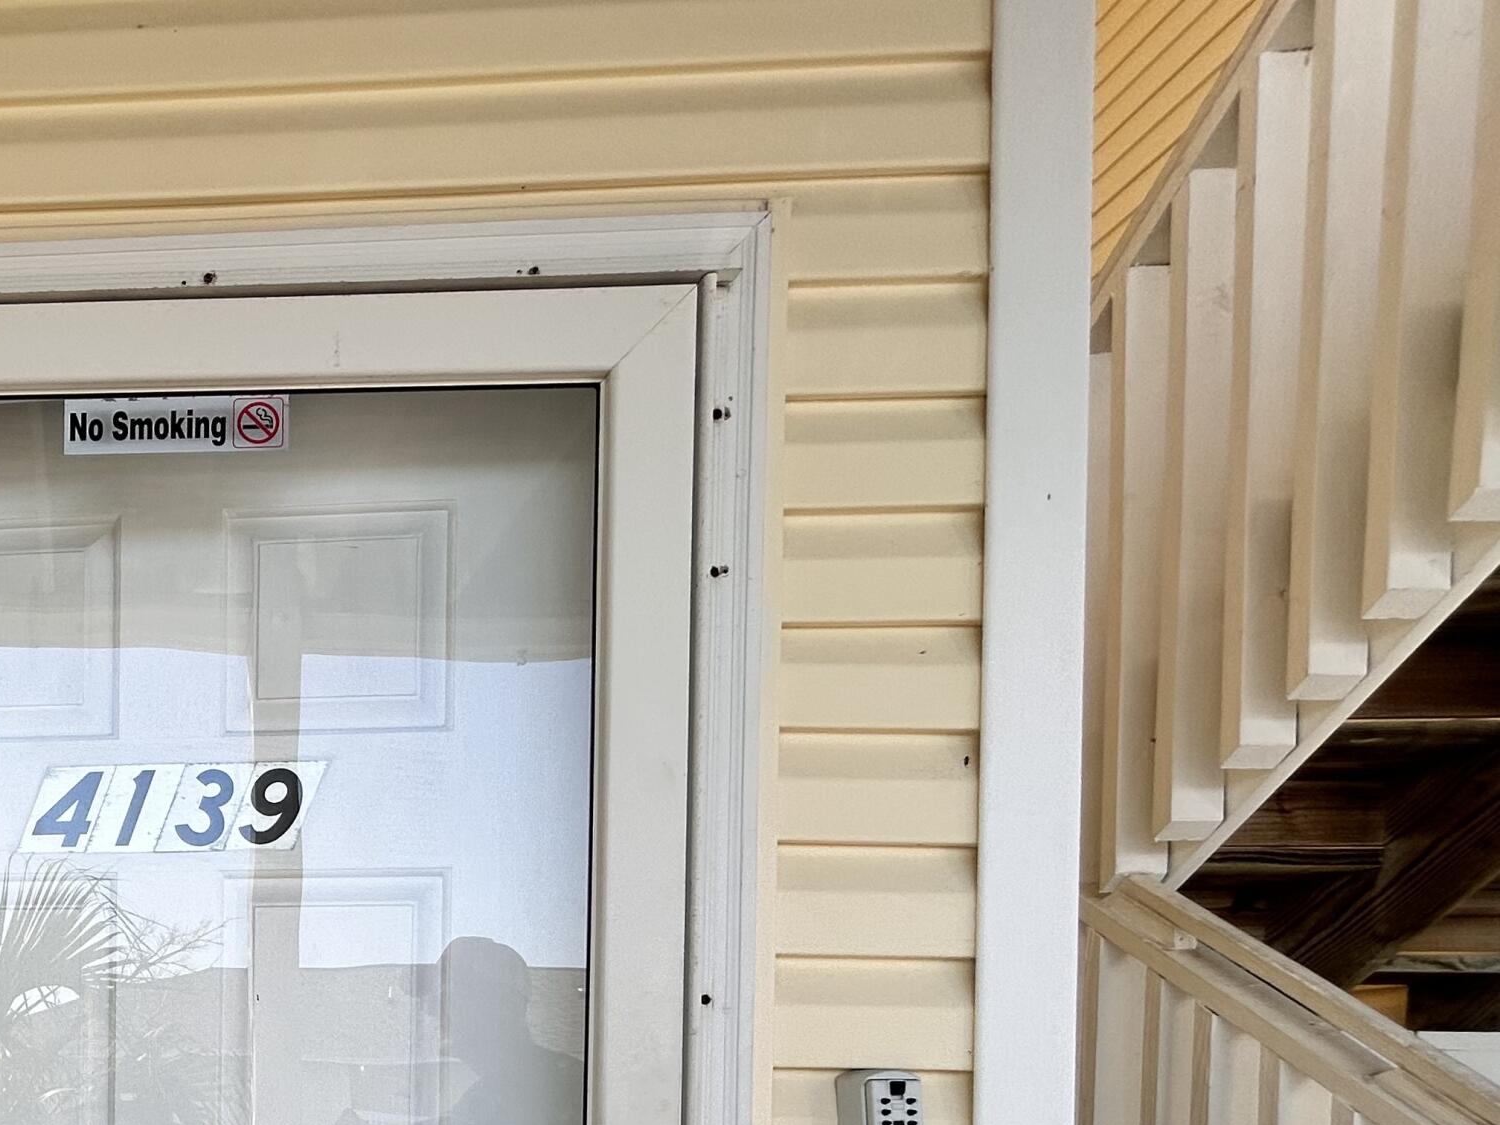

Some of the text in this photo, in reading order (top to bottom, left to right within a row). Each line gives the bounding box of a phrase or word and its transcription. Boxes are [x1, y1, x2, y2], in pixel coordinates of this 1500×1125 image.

[69, 409, 227, 446] No Smoking
[31, 767, 304, 848] 4139
